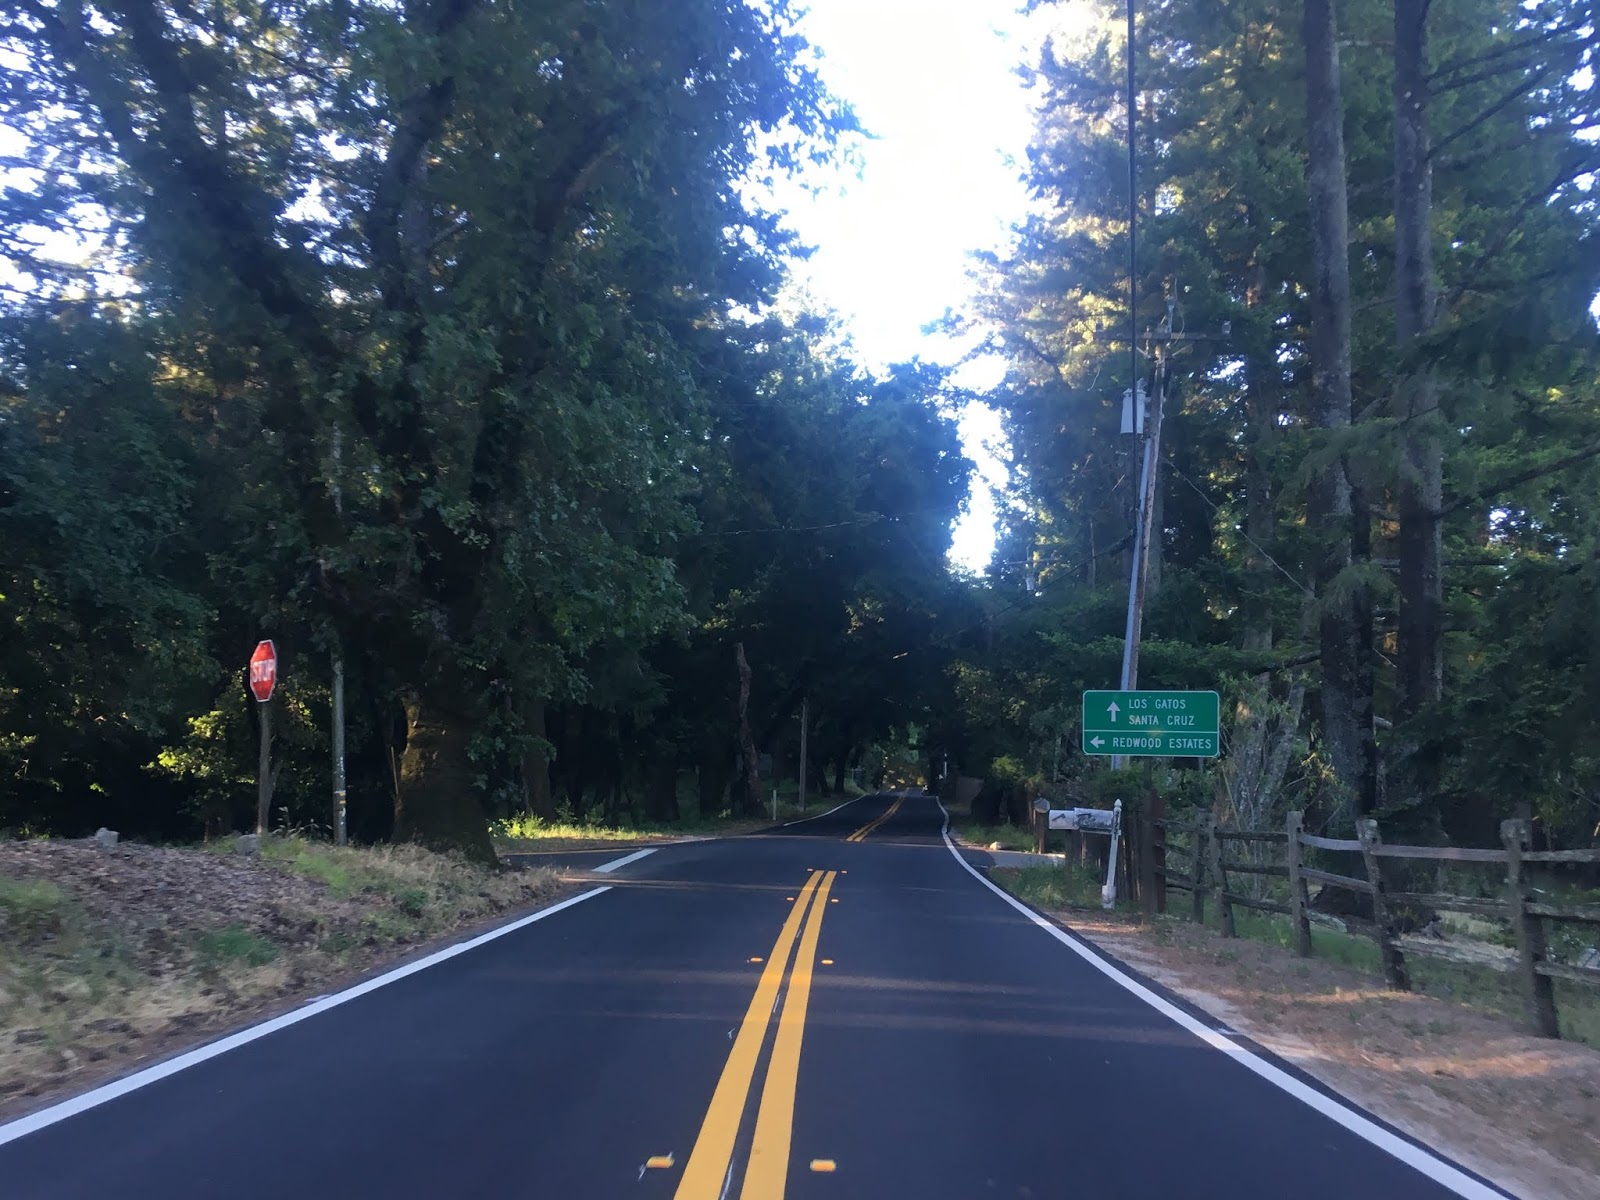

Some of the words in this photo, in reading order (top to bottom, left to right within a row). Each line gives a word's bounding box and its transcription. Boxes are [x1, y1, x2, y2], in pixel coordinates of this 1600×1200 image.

[251, 659, 274, 682] STOP
[1128, 699, 1147, 709] LOS
[1155, 699, 1186, 709] GATOS
[1128, 715, 1159, 725] SANTA
[1167, 715, 1195, 726] CRUZ
[1112, 737, 1162, 748] REDWOOD
[1169, 738, 1212, 749] ESTATES
